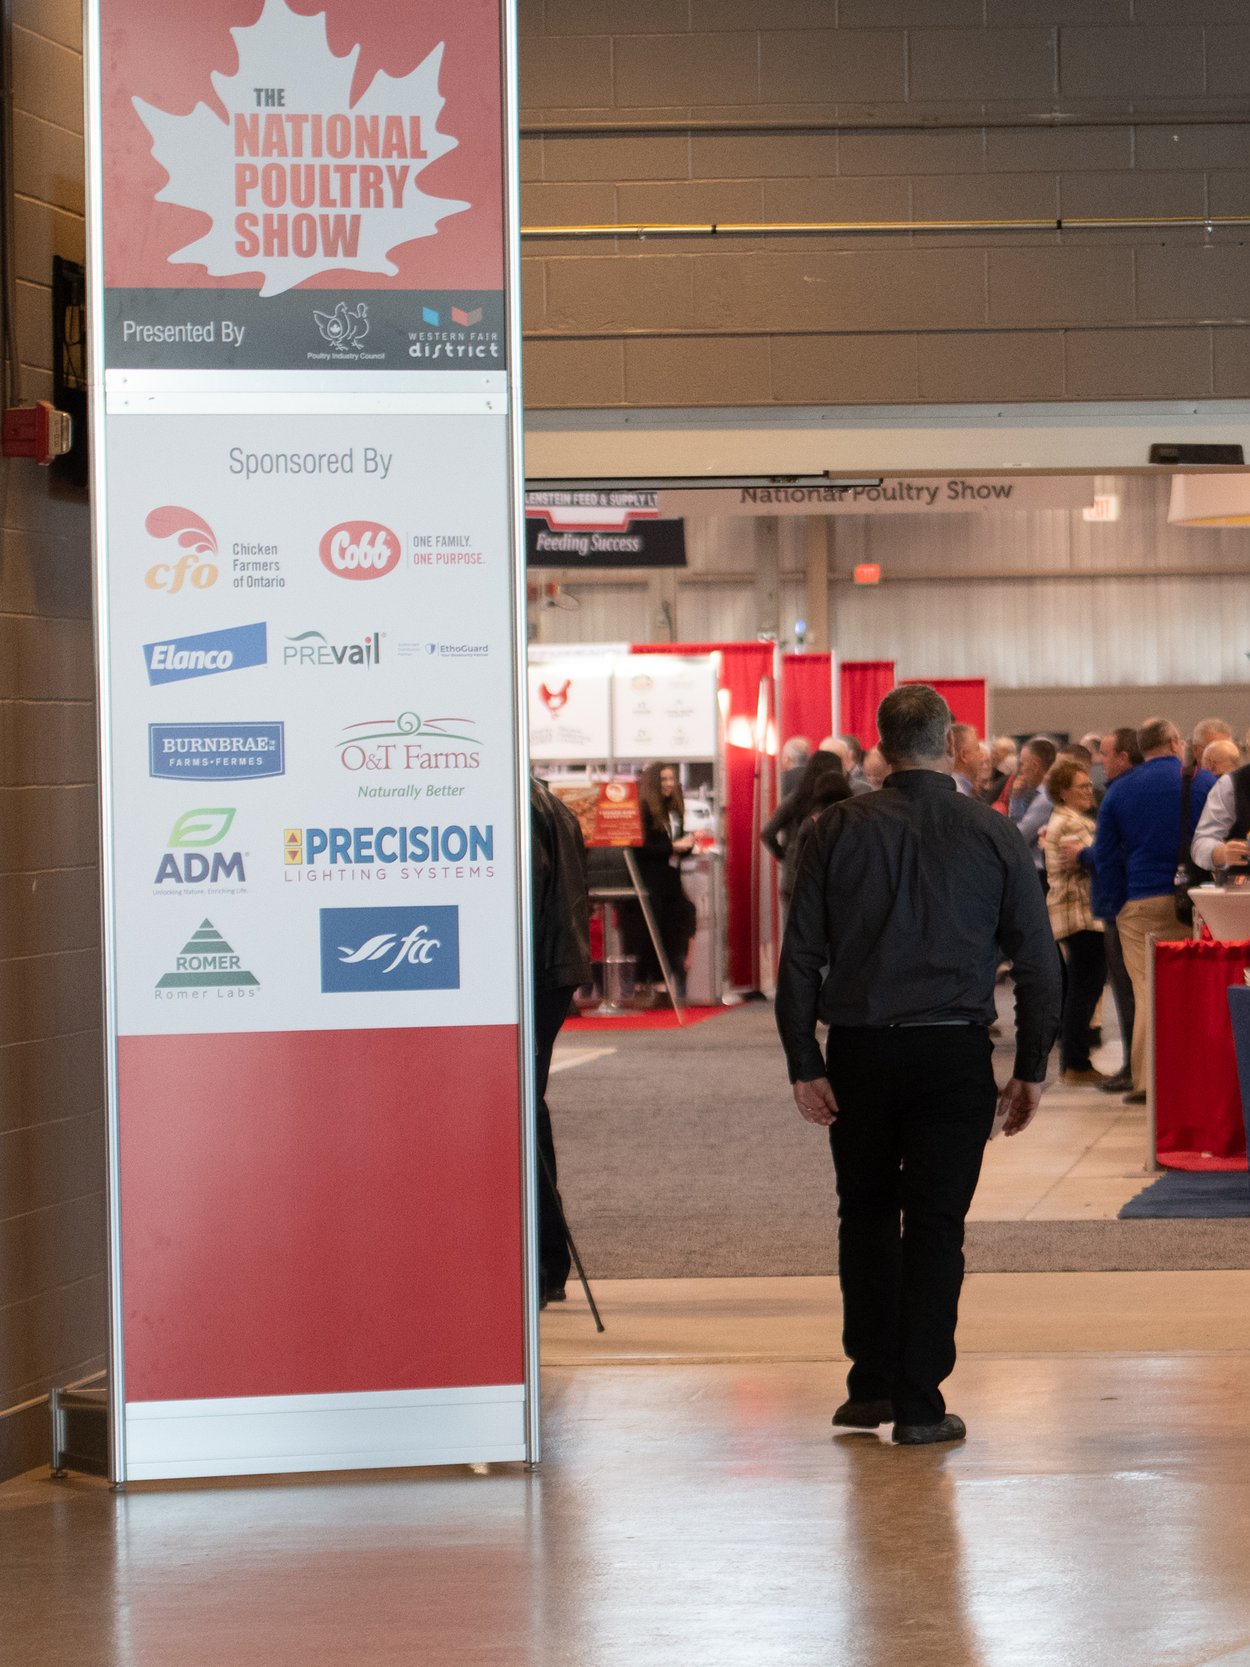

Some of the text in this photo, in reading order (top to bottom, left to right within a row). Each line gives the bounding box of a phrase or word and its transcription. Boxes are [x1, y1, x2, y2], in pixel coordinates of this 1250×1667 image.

[254, 88, 285, 107] THE
[234, 113, 427, 159] NATIONAL
[234, 163, 410, 209] POULTRY
[234, 212, 361, 258] SHOW
[123, 321, 245, 347] Presented By
[408, 332, 498, 341] WESTERN FAIR
[307, 353, 330, 361] Poultry
[332, 353, 359, 361] Industry
[408, 343, 499, 359] district
[229, 447, 393, 480] Sponsored By
[574, 493, 597, 506] FEED
[600, 494, 608, 506] &
[610, 493, 645, 507] SUPPLY
[853, 481, 939, 506] Poultry
[947, 480, 1013, 500] Show
[233, 542, 278, 556] Chicken
[330, 530, 392, 570] Cobb
[413, 535, 472, 548] ONE FAMILY.
[536, 533, 641, 556] Feeding Success
[233, 558, 280, 572] Farmers
[413, 552, 486, 565] ONE PURPOSE.
[144, 554, 220, 594] cfo
[233, 575, 286, 588] of Ontario
[150, 645, 234, 671] Elanco
[440, 645, 488, 653] EthoGuard
[162, 737, 269, 753] BURNBRAE
[340, 743, 480, 771] O&T Farms
[358, 784, 465, 800] Naturally Better
[305, 824, 494, 865] PRECISION
[154, 851, 247, 884] ADM
[284, 866, 495, 882] LIGHTING SYSTEMS
[382, 925, 441, 974] fcc
[176, 955, 241, 972] ROMER
[155, 987, 256, 1000] Romer Labs
